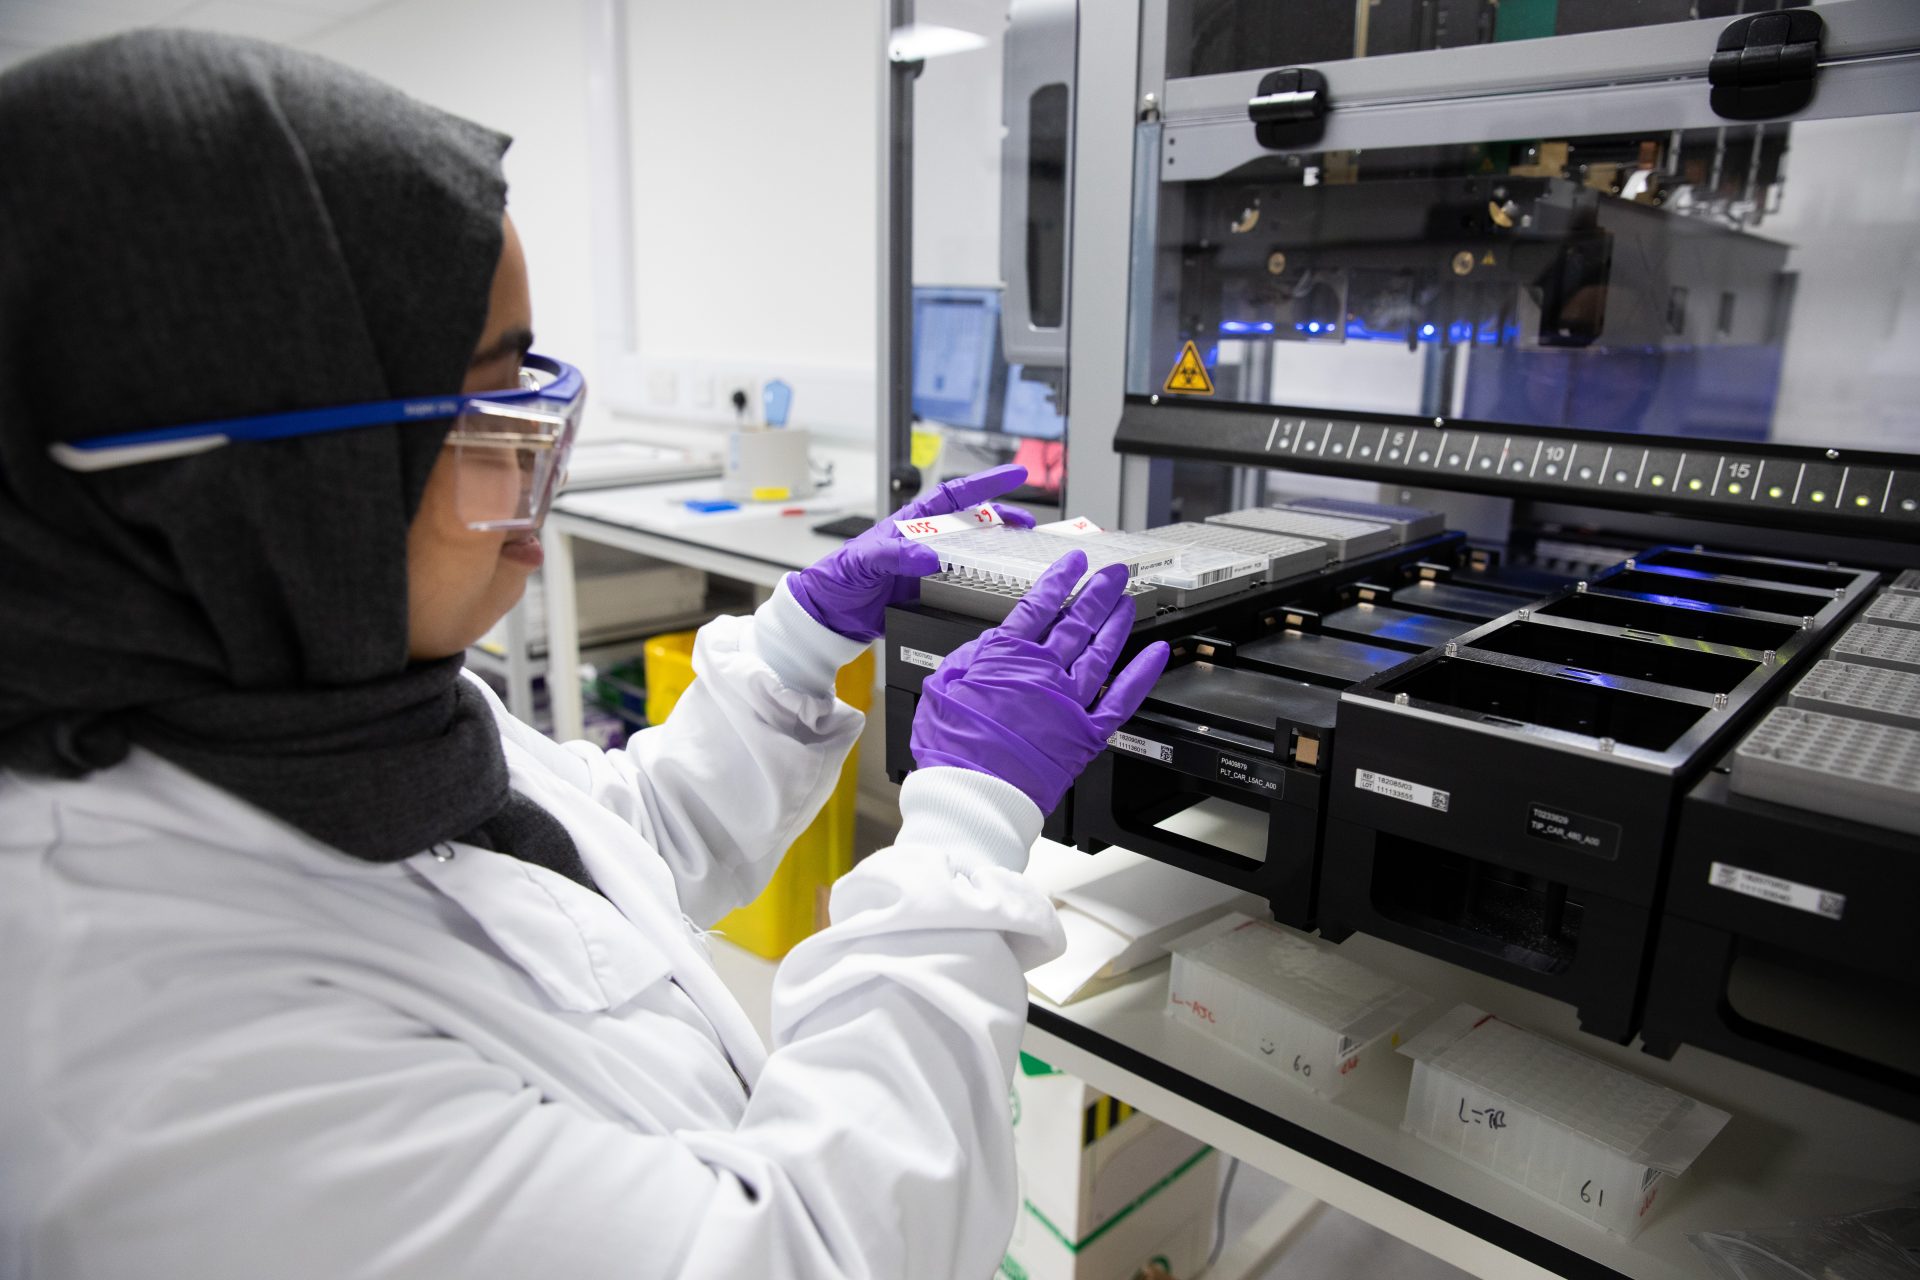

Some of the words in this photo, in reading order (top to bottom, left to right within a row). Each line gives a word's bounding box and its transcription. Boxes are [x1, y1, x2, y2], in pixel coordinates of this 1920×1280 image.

[1284, 422, 1292, 436] 1
[1393, 431, 1405, 446] 5
[1546, 447, 1565, 461] 10
[1729, 462, 1751, 478] 15
[1361, 781, 1373, 789] LOT
[1376, 785, 1414, 801] 111133555
[1362, 772, 1374, 780] REF
[1377, 776, 1413, 791] 182085/03
[1293, 1054, 1312, 1077] 60
[1580, 1179, 1604, 1207] 61
